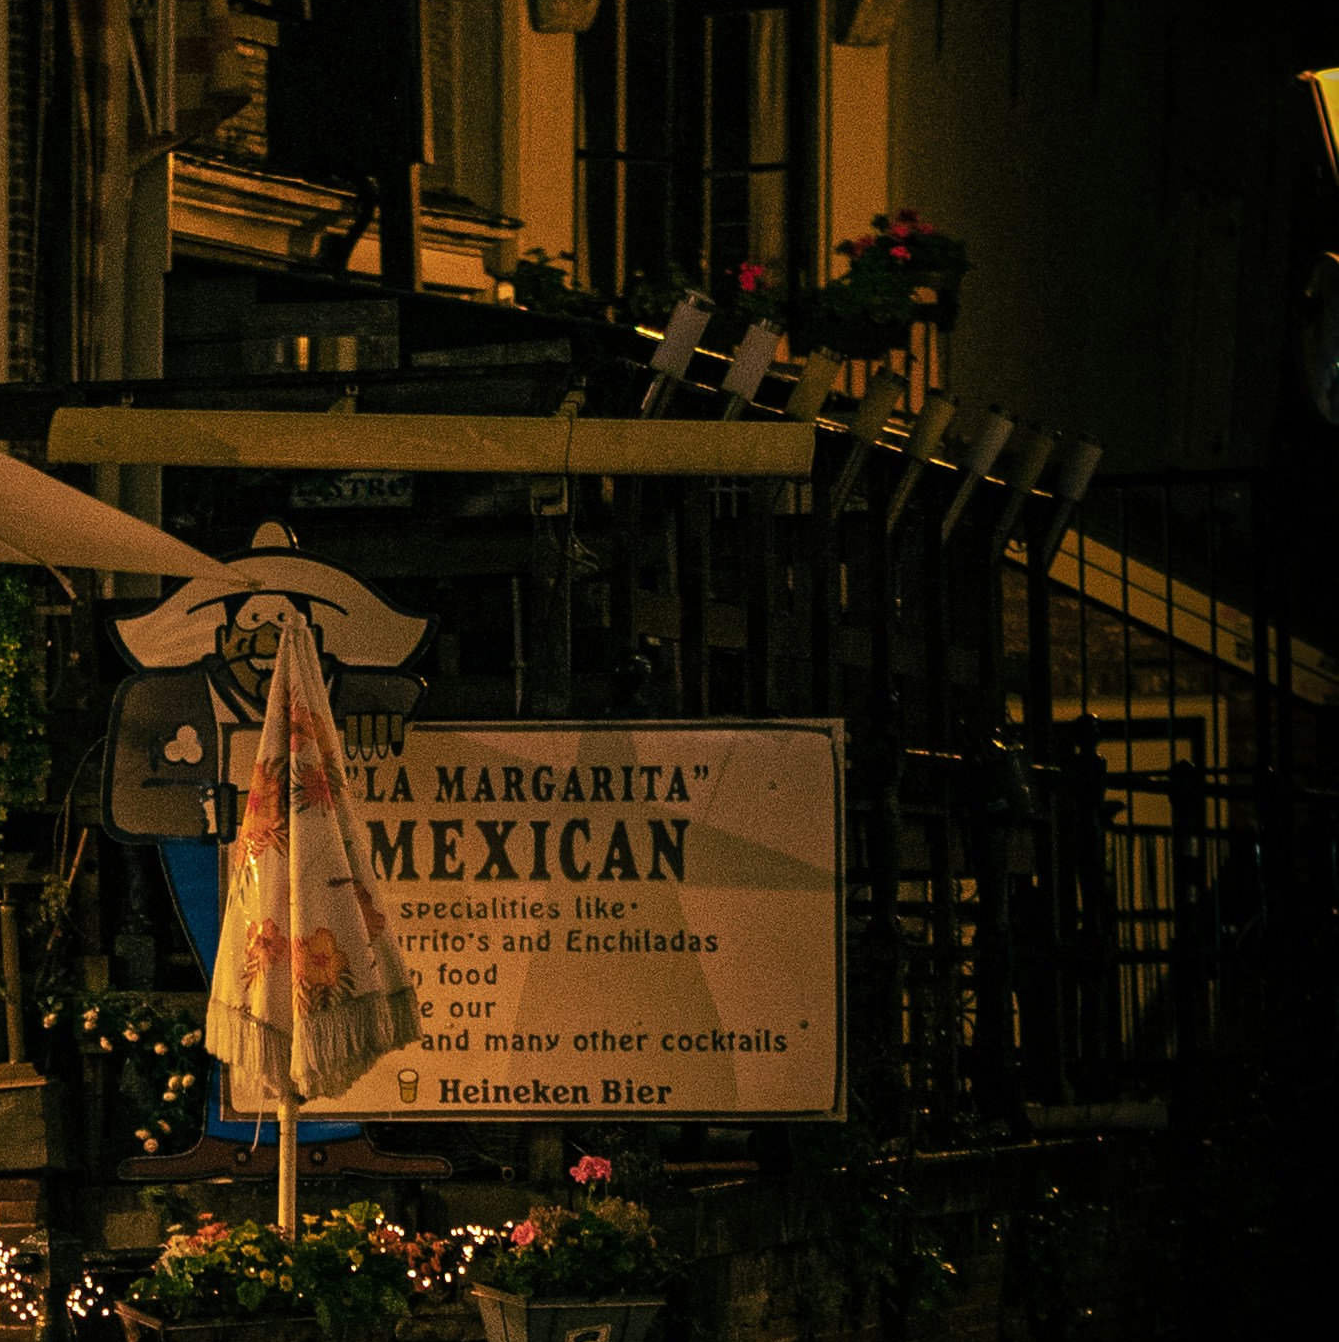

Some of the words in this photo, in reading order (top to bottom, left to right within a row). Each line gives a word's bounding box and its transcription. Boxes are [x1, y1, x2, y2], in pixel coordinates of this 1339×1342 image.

[435, 765, 710, 803] MARGARITA"
[366, 817, 691, 882] MEXICAN
[400, 896, 561, 920] specialities
[397, 928, 490, 953] rrito's
[502, 929, 551, 953] and
[566, 928, 719, 953] Enchiladas
[437, 962, 498, 986] food
[449, 1001, 497, 1019] our
[420, 1028, 470, 1052] and
[484, 1032, 561, 1053] many
[573, 1028, 649, 1053] other
[660, 1028, 788, 1053] cocktails
[438, 1078, 591, 1105] Heineken
[601, 1078, 673, 1105] Bier
